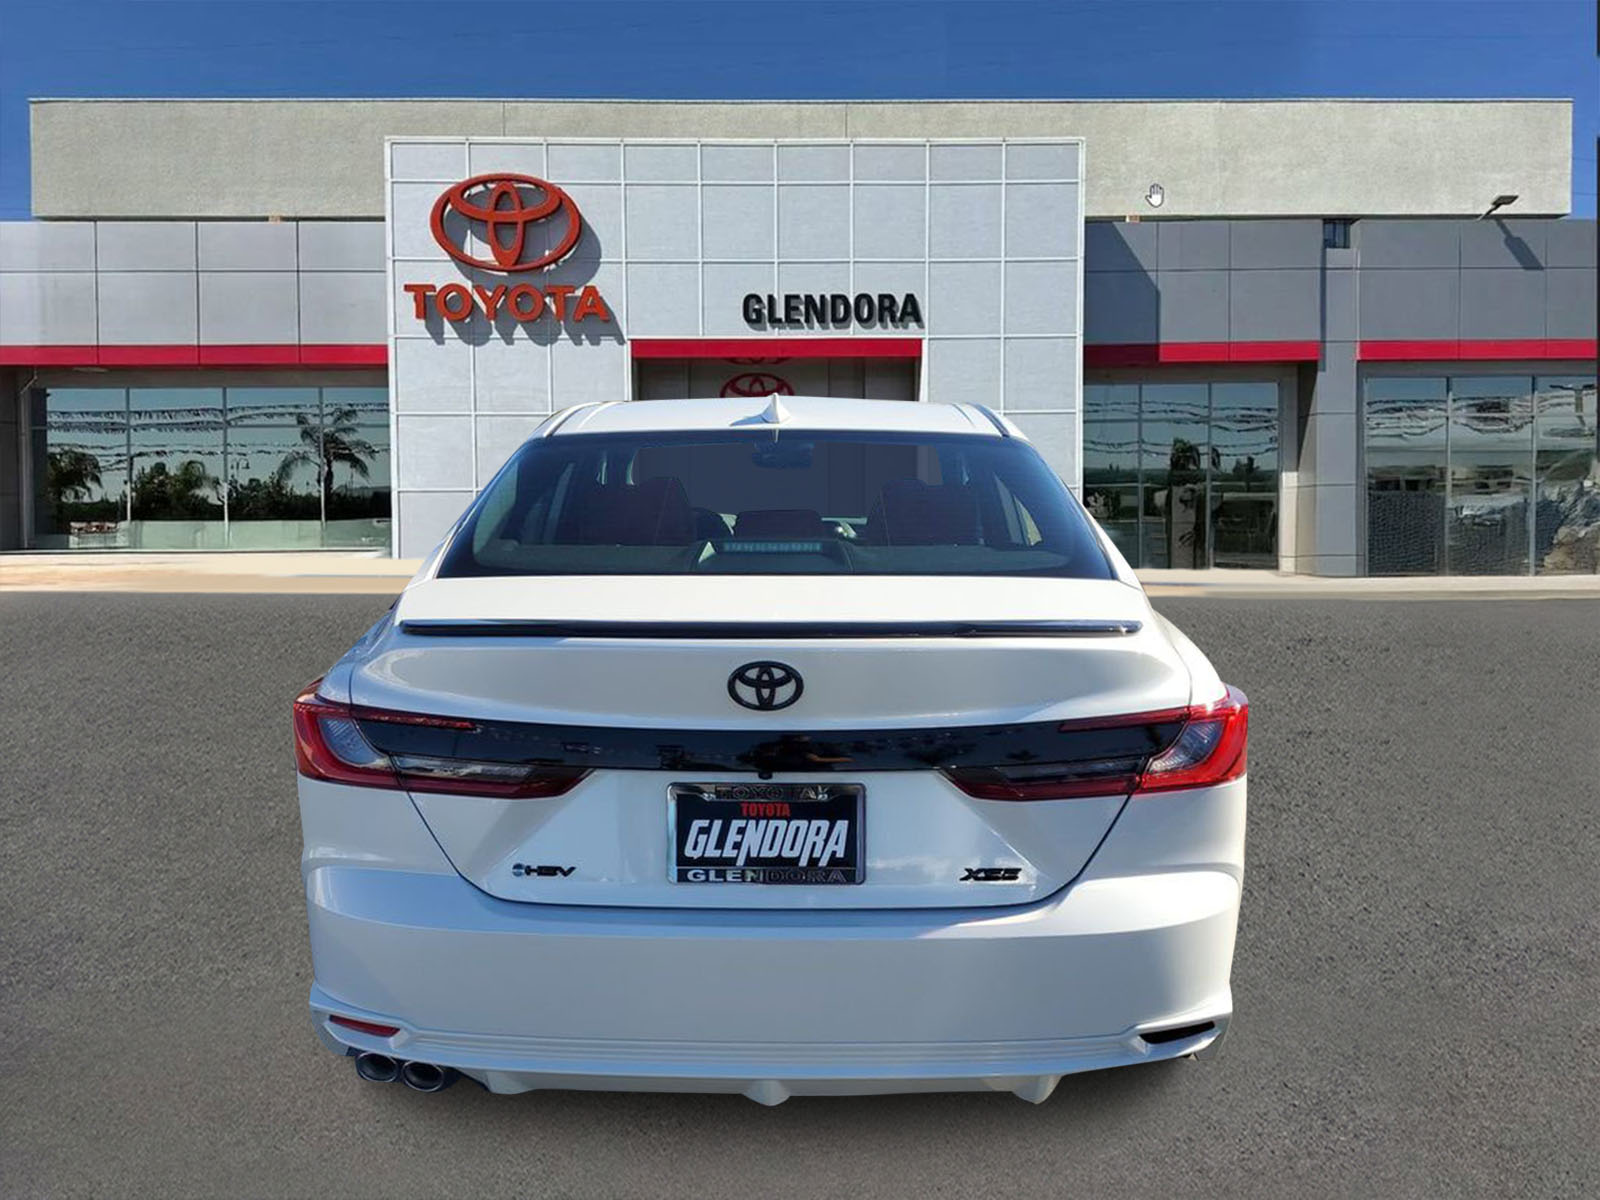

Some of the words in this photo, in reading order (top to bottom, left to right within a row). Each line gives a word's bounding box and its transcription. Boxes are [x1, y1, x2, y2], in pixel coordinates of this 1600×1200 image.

[404, 284, 611, 322] TOYOTA
[742, 293, 923, 325] GLENDORA
[716, 785, 818, 800] TOYOA
[741, 803, 790, 817] TOYOTA
[684, 819, 849, 867] GLENDORA
[687, 869, 846, 882] GLENDORA
